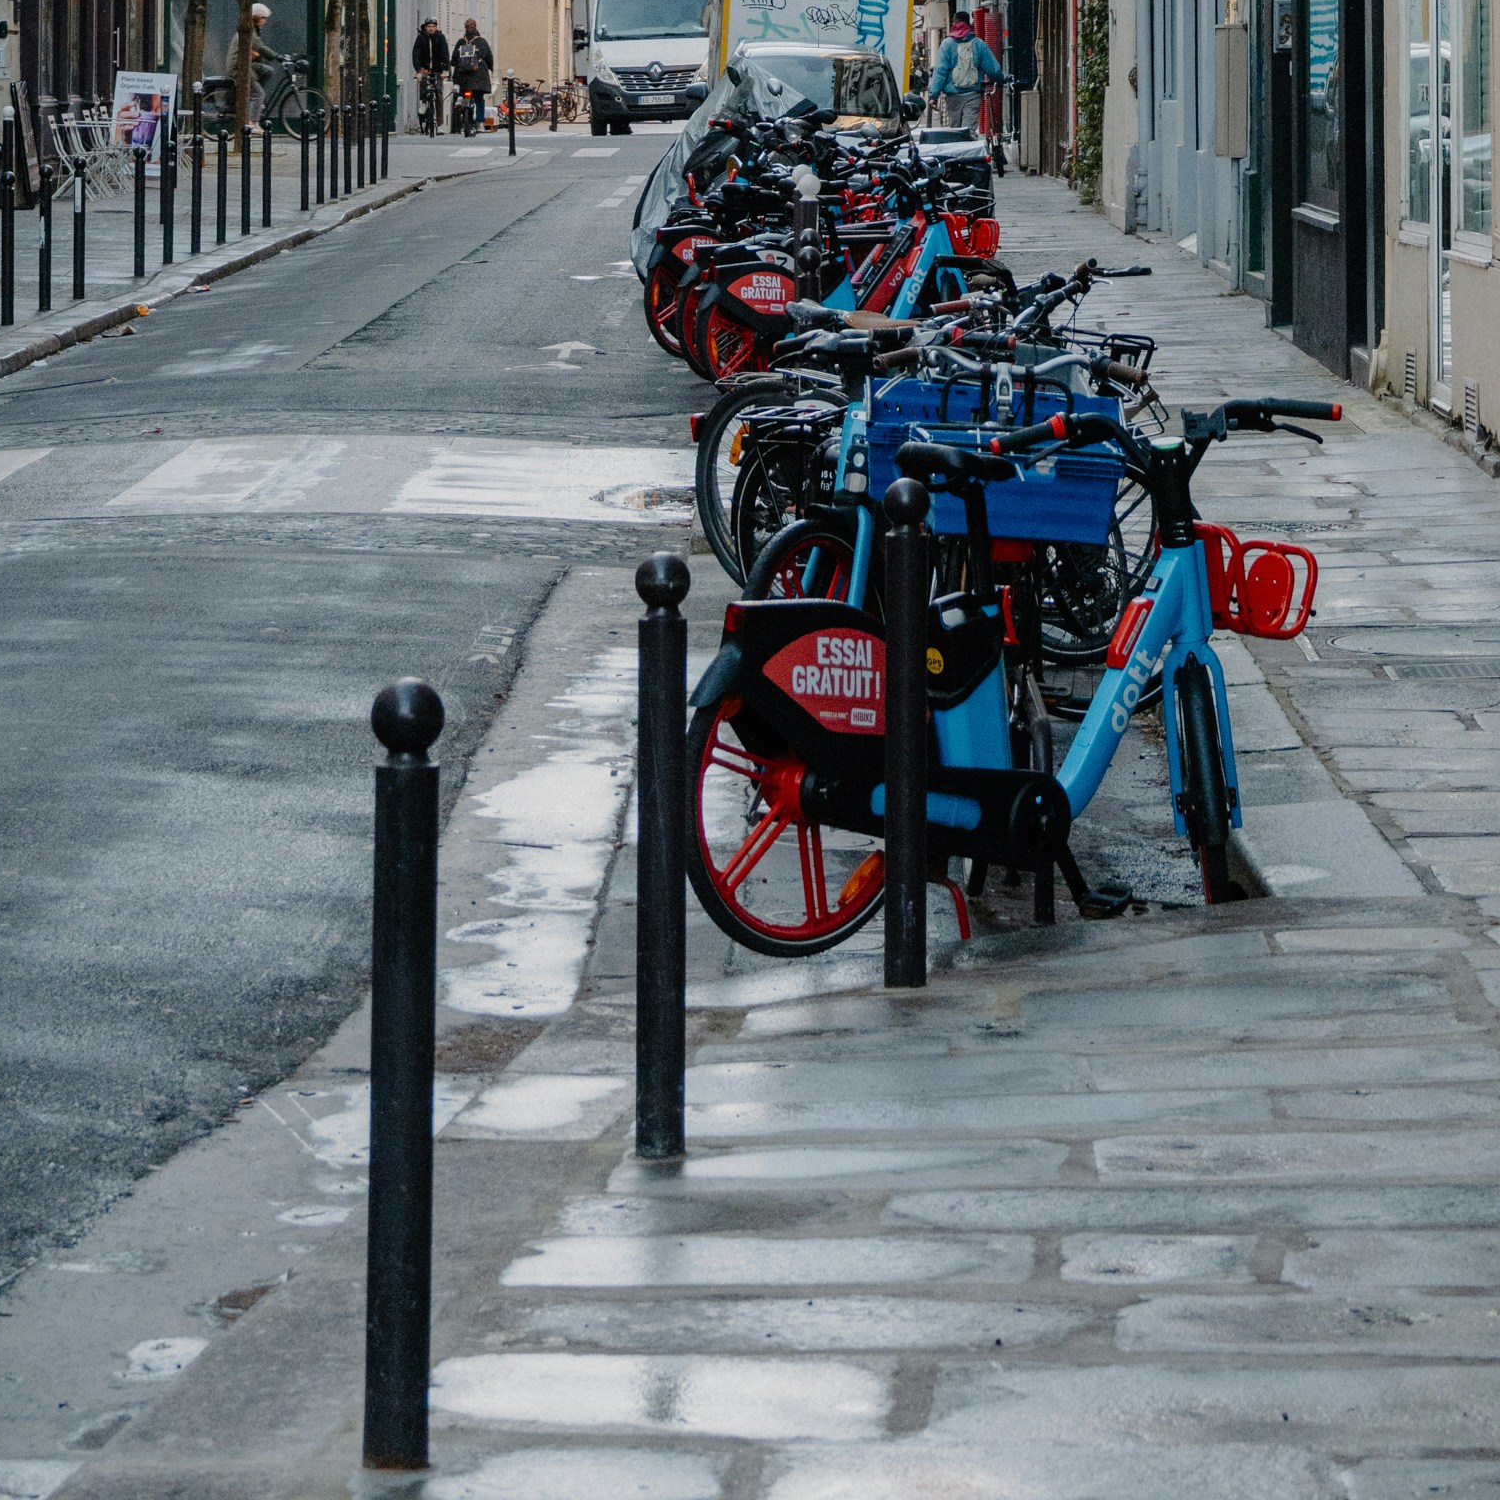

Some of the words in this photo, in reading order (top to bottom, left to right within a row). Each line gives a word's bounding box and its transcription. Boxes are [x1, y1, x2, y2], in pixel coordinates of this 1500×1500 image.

[740, 286, 786, 301] GRATUIT!
[752, 274, 781, 288] ESSAI
[906, 267, 928, 305] dott
[817, 636, 872, 668] ESSAI
[792, 665, 880, 700] GRATUIT!
[1111, 648, 1157, 733] dott
[853, 711, 874, 723] HIBIKE
